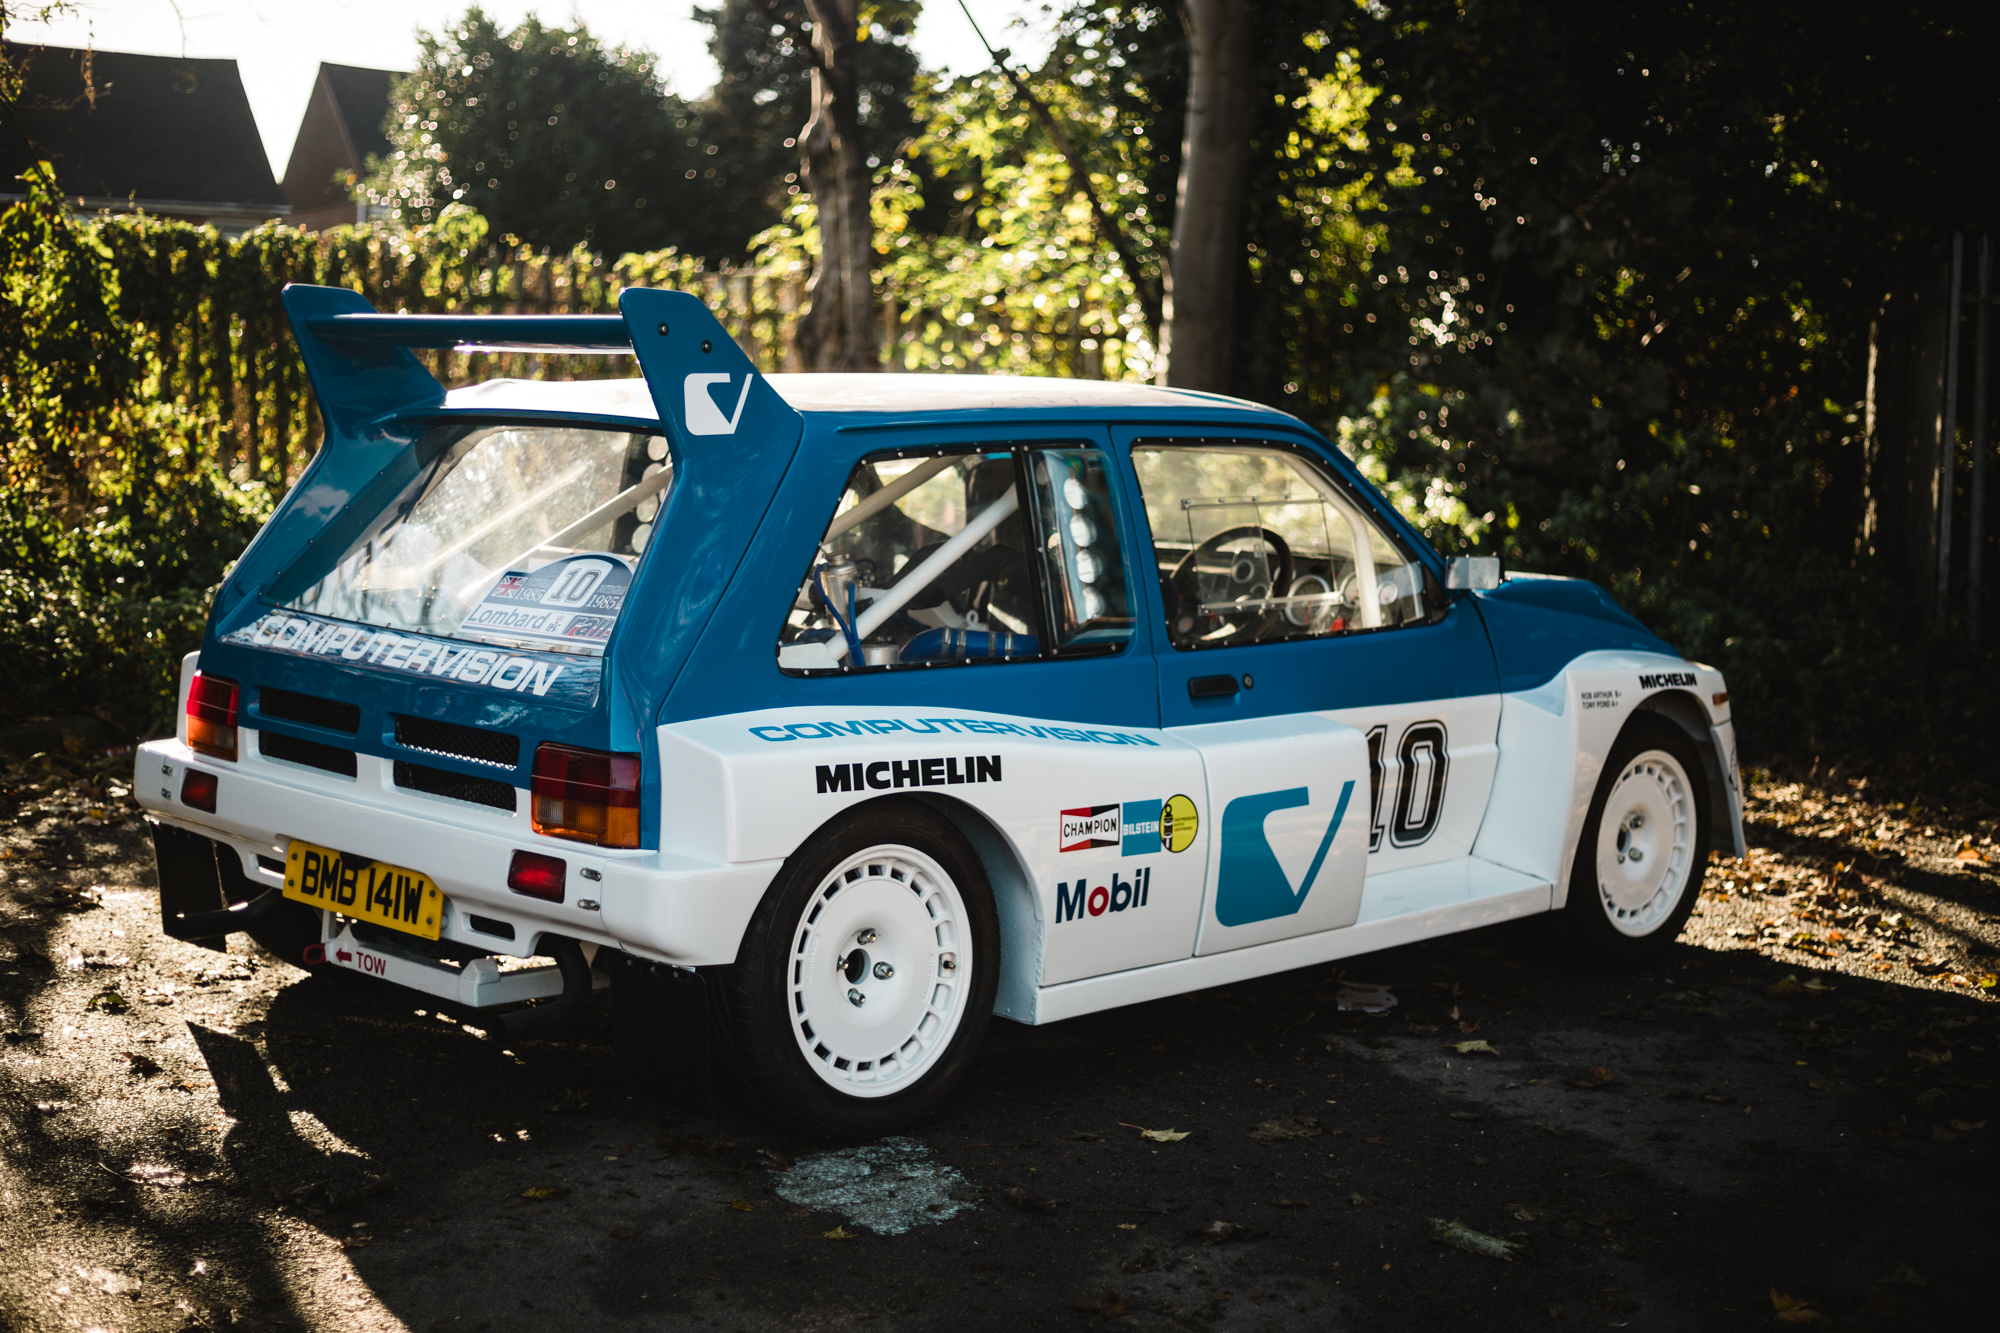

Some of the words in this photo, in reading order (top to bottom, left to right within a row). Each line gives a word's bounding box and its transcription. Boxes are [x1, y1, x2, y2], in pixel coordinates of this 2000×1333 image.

[514, 587, 546, 602] 1985
[547, 567, 602, 604] 10
[586, 594, 619, 609] 1985
[468, 605, 552, 630] Lombard
[252, 615, 564, 697] COMPUTERVISION
[1638, 672, 1697, 689] MICHELIN
[749, 718, 1161, 746] COMPUTERVISION
[815, 755, 1002, 793] MICHELIN
[1365, 719, 1450, 854] 10
[1063, 818, 1117, 837] CHAMPION
[1123, 820, 1160, 836] BILSTEIN
[300, 850, 359, 907] BMB
[365, 867, 425, 925] 141W
[1055, 867, 1150, 924] Mobil
[355, 951, 386, 976] TOW
